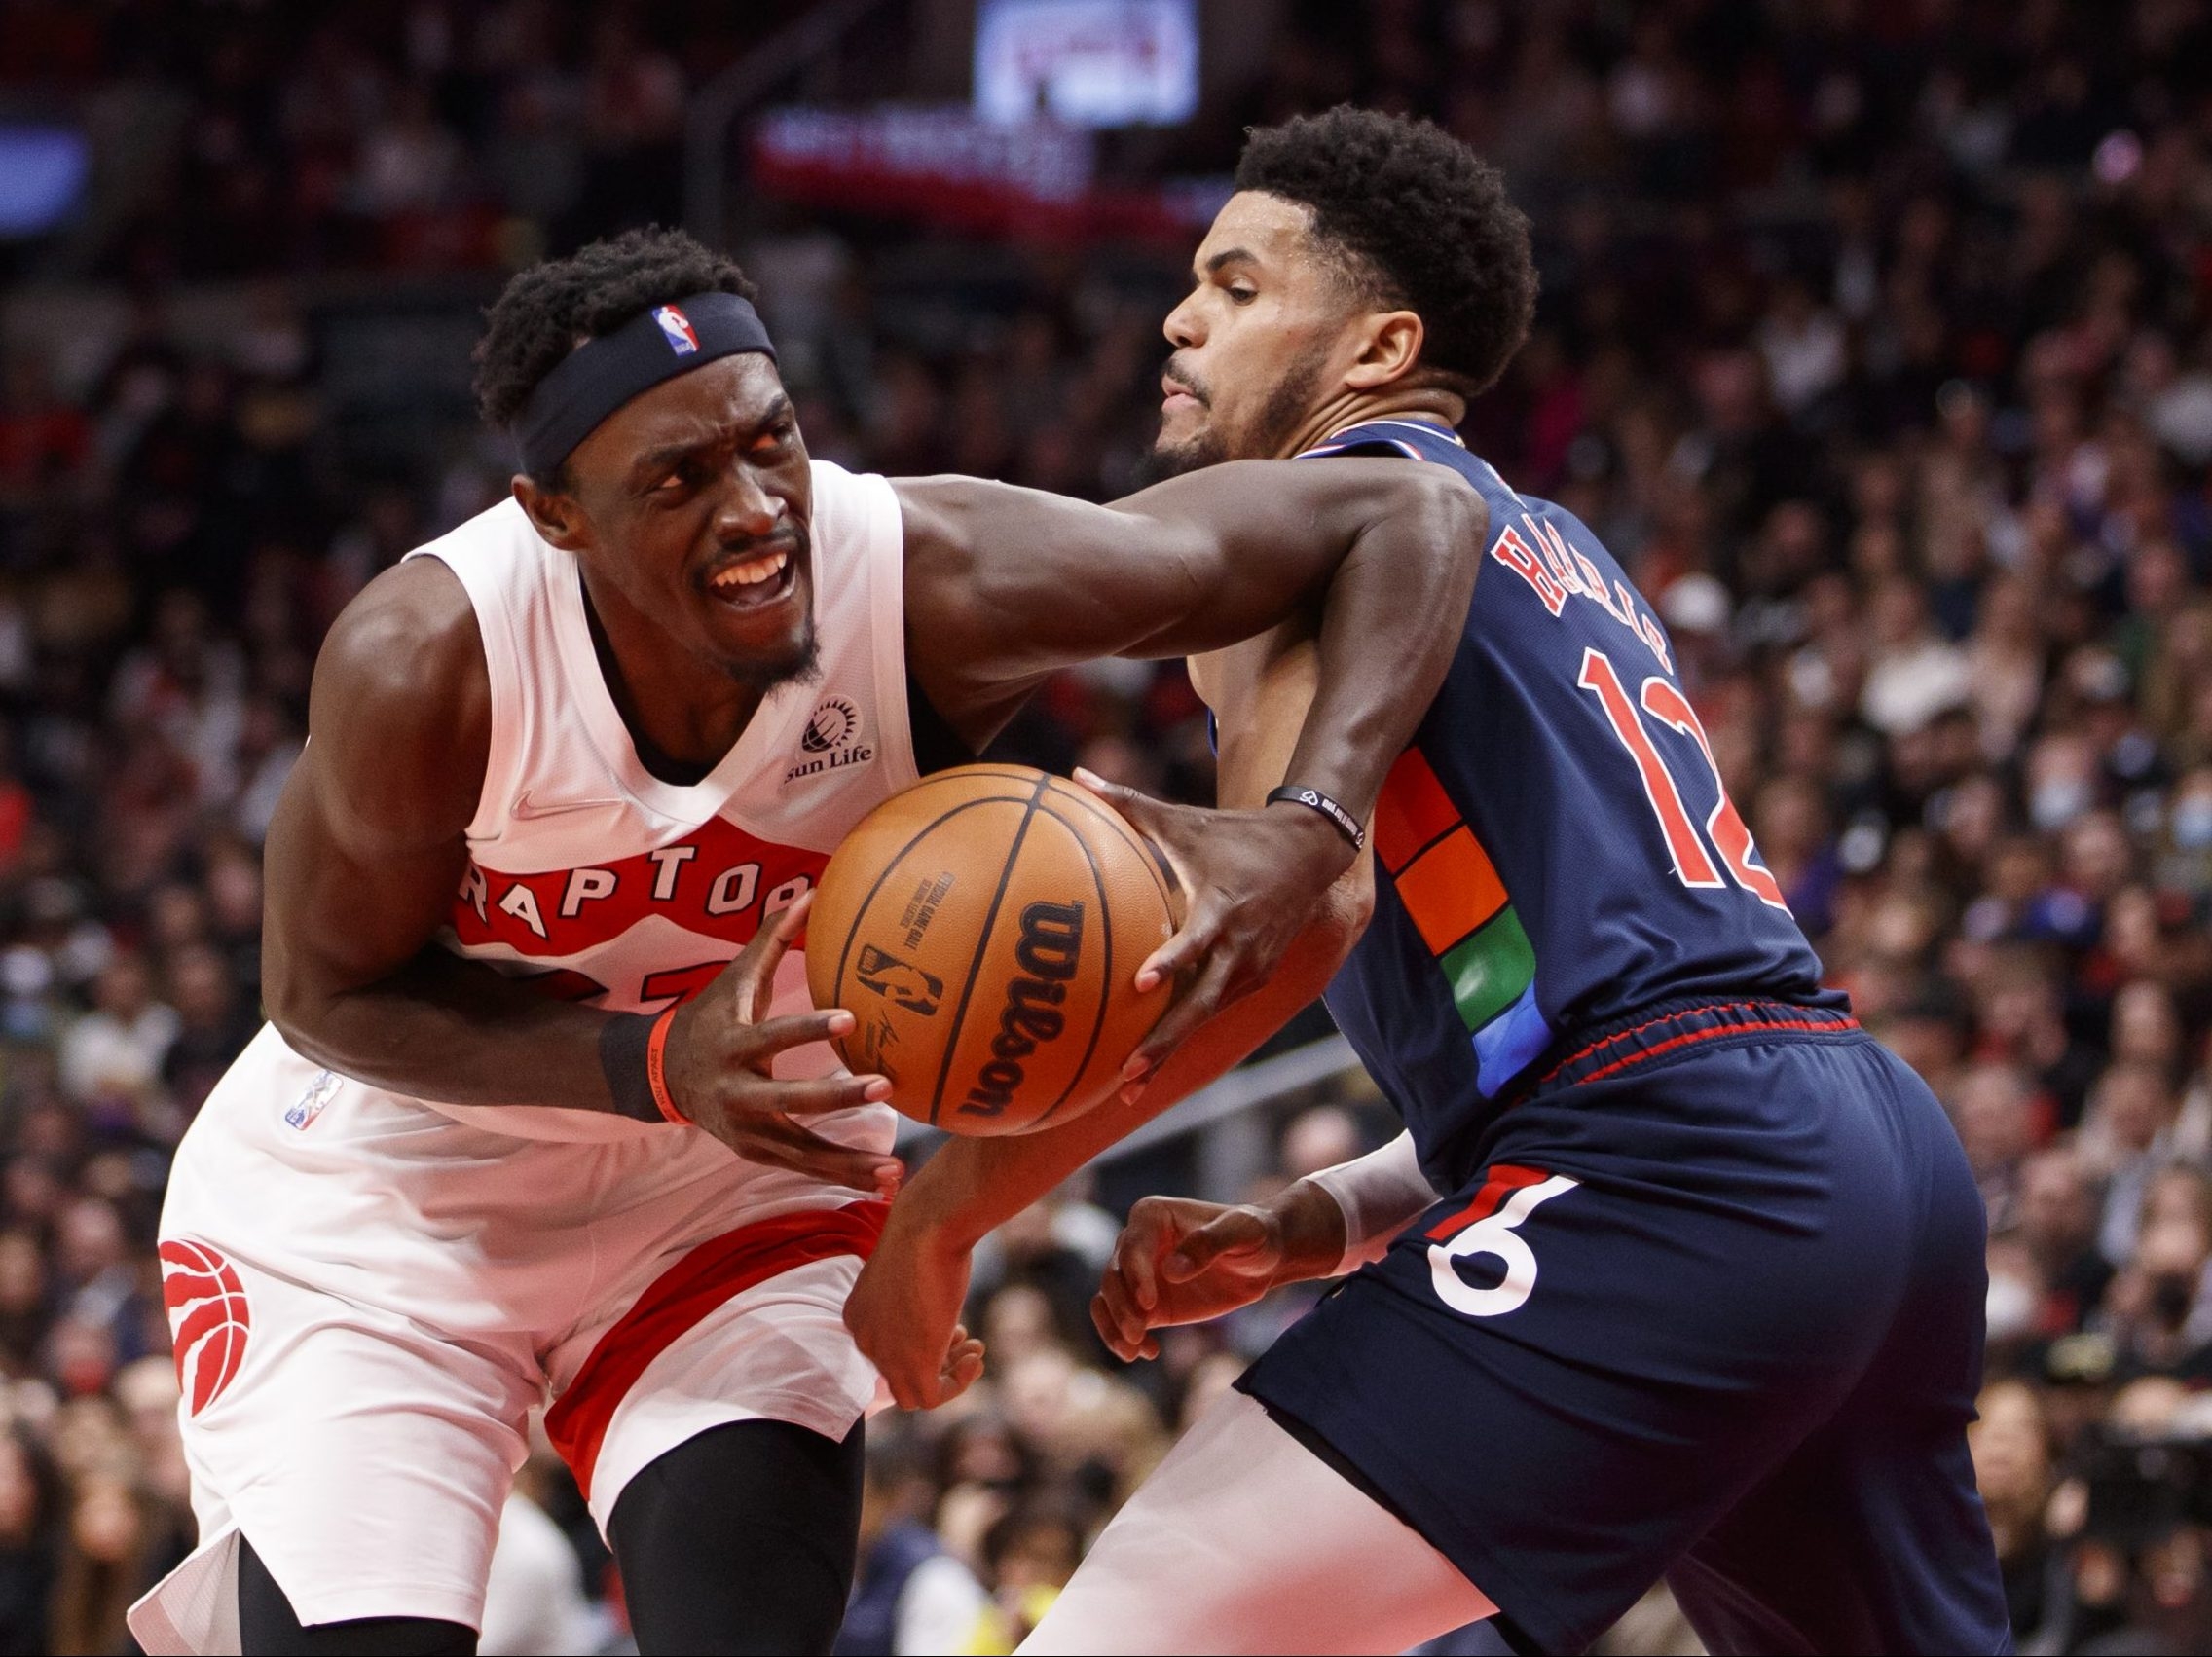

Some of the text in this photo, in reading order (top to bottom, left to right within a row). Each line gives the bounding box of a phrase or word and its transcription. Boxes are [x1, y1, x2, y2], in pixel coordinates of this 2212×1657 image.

[829, 745, 872, 768] Life
[1578, 647, 1794, 920] 12
[903, 928, 924, 950] BALL
[957, 900, 1085, 1117] Wilson
